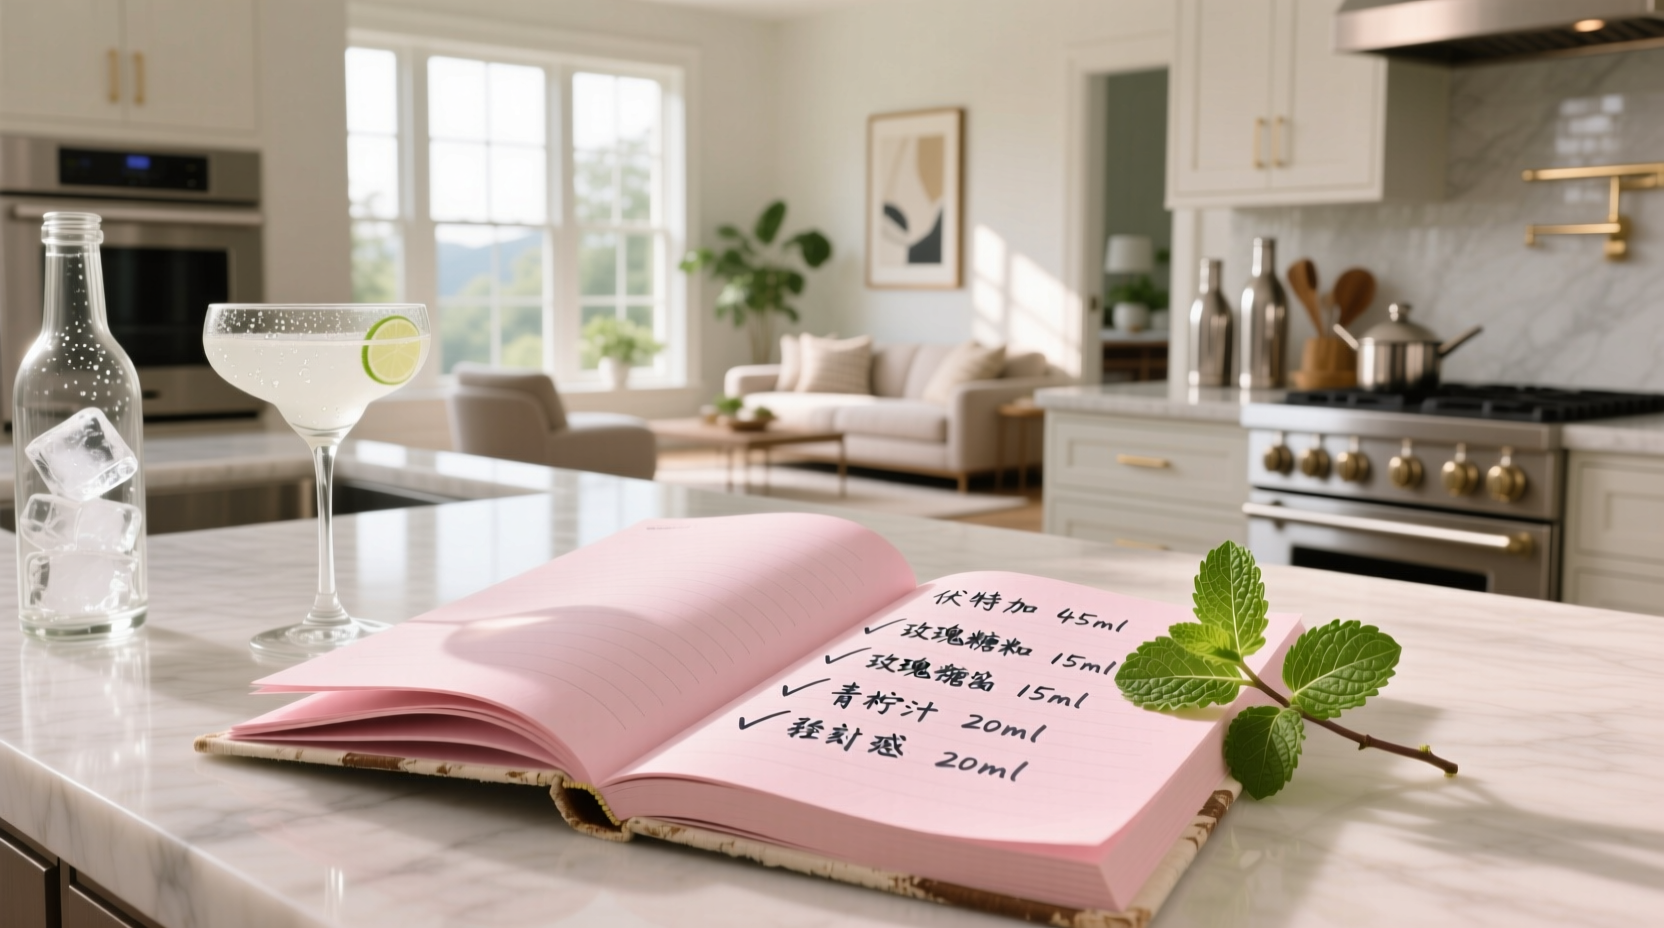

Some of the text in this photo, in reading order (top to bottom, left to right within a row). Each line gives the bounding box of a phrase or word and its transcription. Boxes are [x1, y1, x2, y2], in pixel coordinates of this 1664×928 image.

[935, 590, 1129, 632] 伏特加 45ml
[1051, 653, 1117, 676] 15ml
[1017, 685, 1090, 709] 15ml
[832, 682, 1047, 744] 青柠汁 20ml
[934, 751, 1029, 781] 20ml
